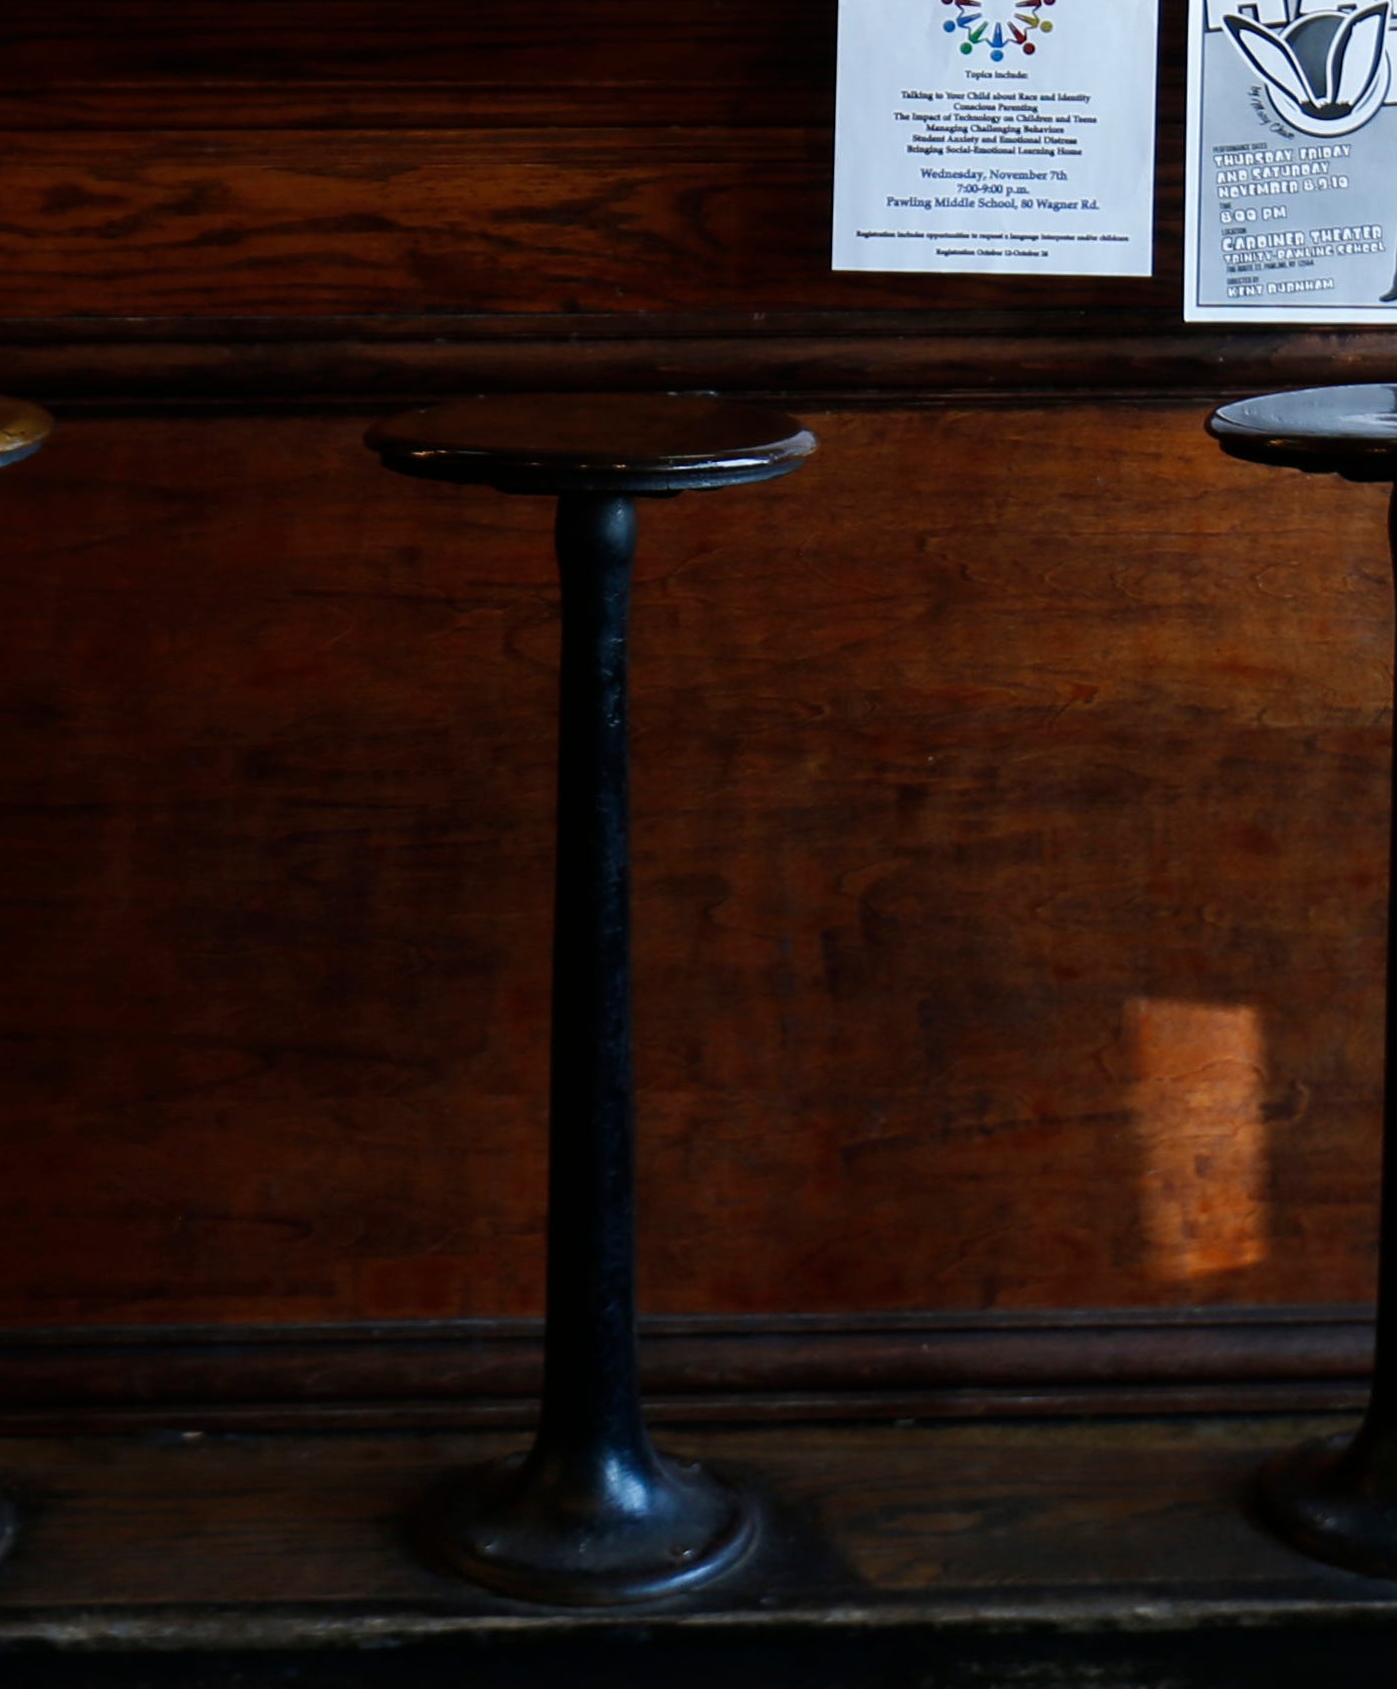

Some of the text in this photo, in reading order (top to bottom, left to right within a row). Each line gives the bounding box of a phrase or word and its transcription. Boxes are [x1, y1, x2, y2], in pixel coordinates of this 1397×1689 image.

[964, 69, 993, 80] Topics
[901, 90, 933, 102] Talking
[967, 90, 991, 101] Child
[1214, 143, 1352, 168] THURSDAY FRIDAY
[921, 167, 1068, 182] Wednesday, November 7th
[1216, 161, 1331, 185] AND SATURDAY
[956, 183, 1030, 197] 7:00-9:00 p.m.
[1217, 179, 1300, 199] NOVEMBER
[886, 196, 932, 211] Pawling
[934, 197, 976, 209] Middle
[978, 198, 1018, 211] School,
[1036, 199, 1079, 212] Wagner
[1081, 199, 1101, 211] Rd.
[1262, 204, 1288, 221] PM
[1309, 223, 1383, 244] THEATER
